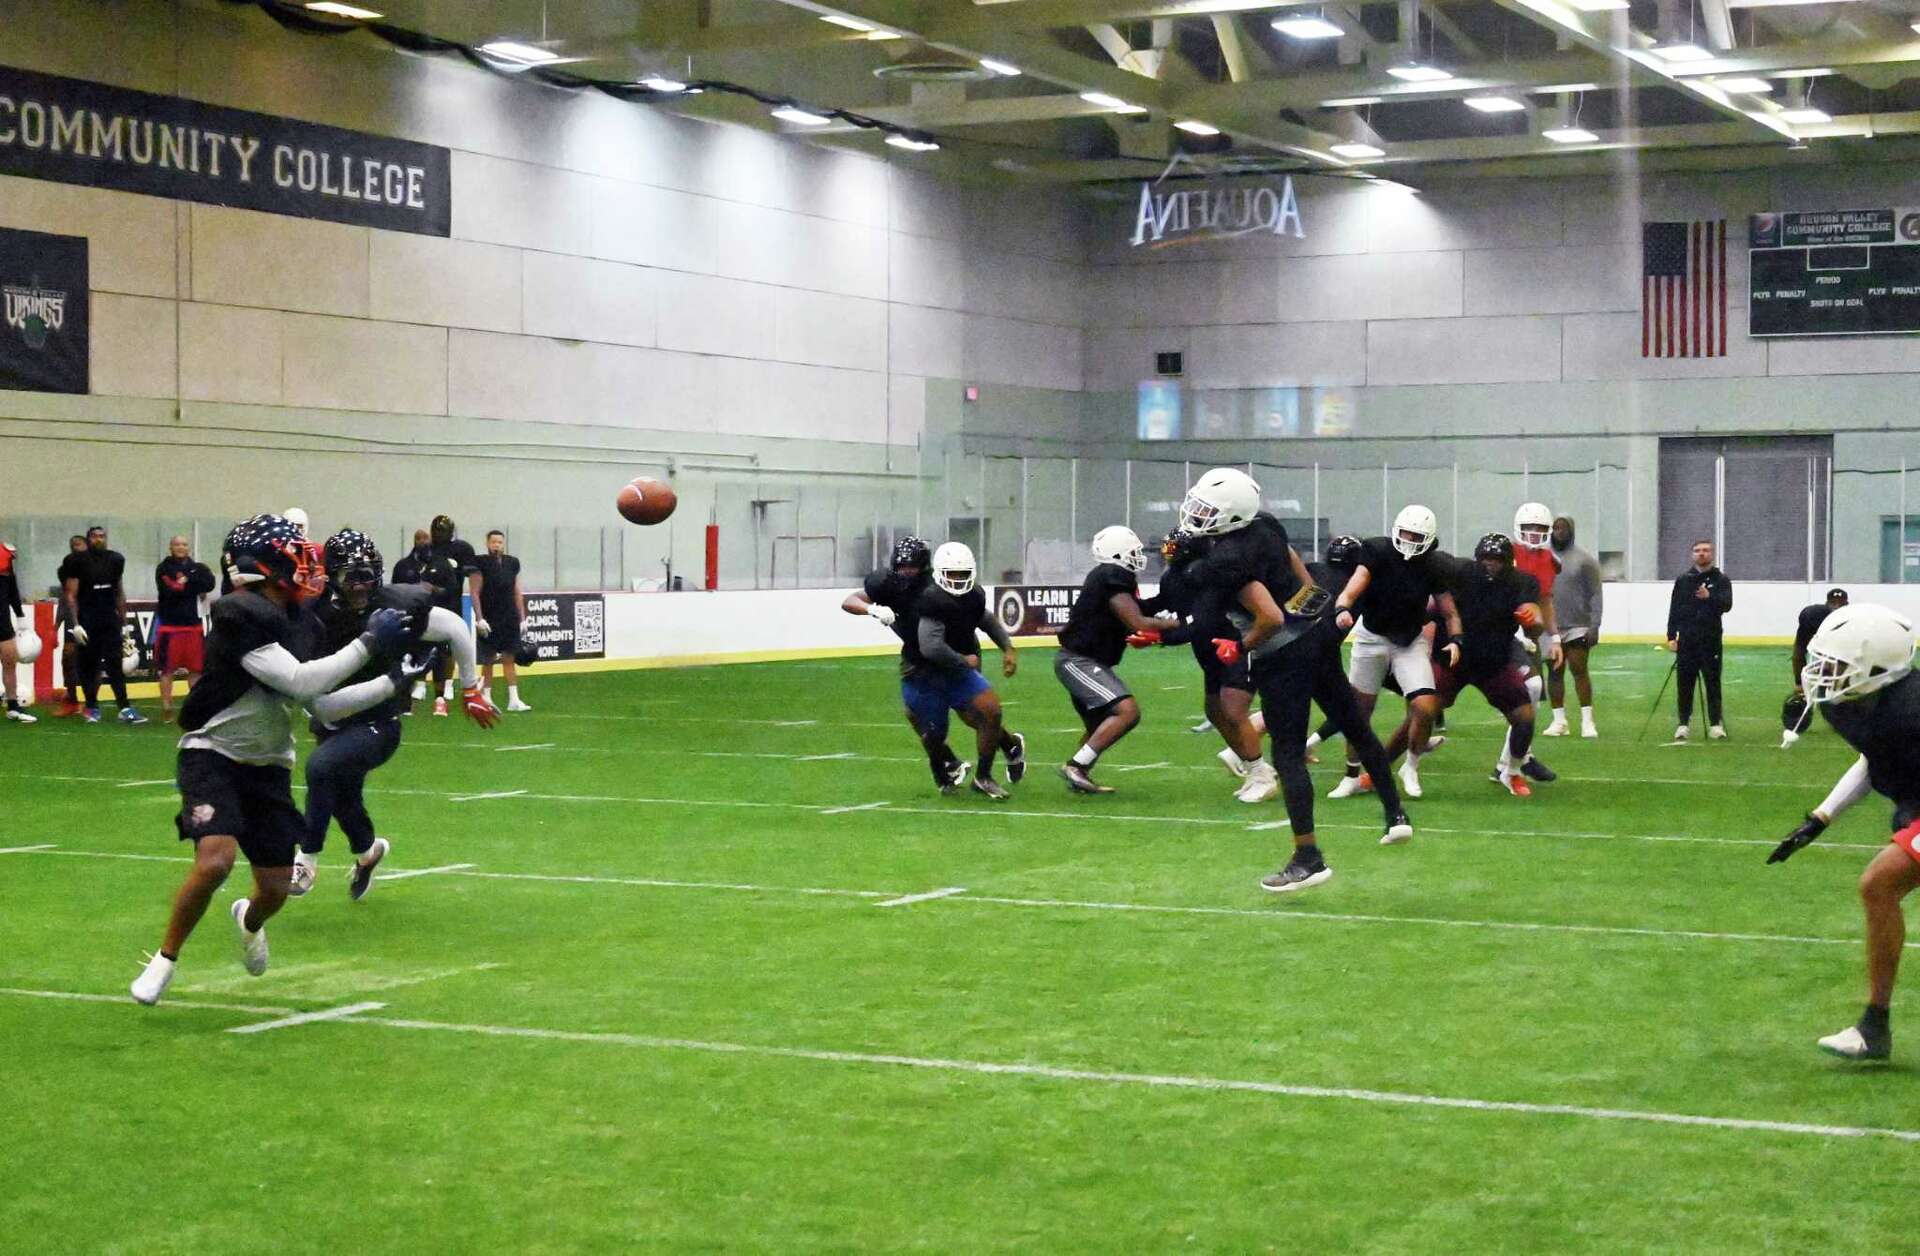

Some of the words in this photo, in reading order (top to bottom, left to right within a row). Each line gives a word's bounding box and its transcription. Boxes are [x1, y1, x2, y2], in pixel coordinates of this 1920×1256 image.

[0, 96, 260, 182] COMMUNITY
[274, 144, 425, 208] COLLEGE
[527, 599, 559, 612] CAMPS,
[1027, 589, 1069, 607] LEARN
[526, 615, 560, 628] CLINICS,
[1046, 607, 1071, 624] THE
